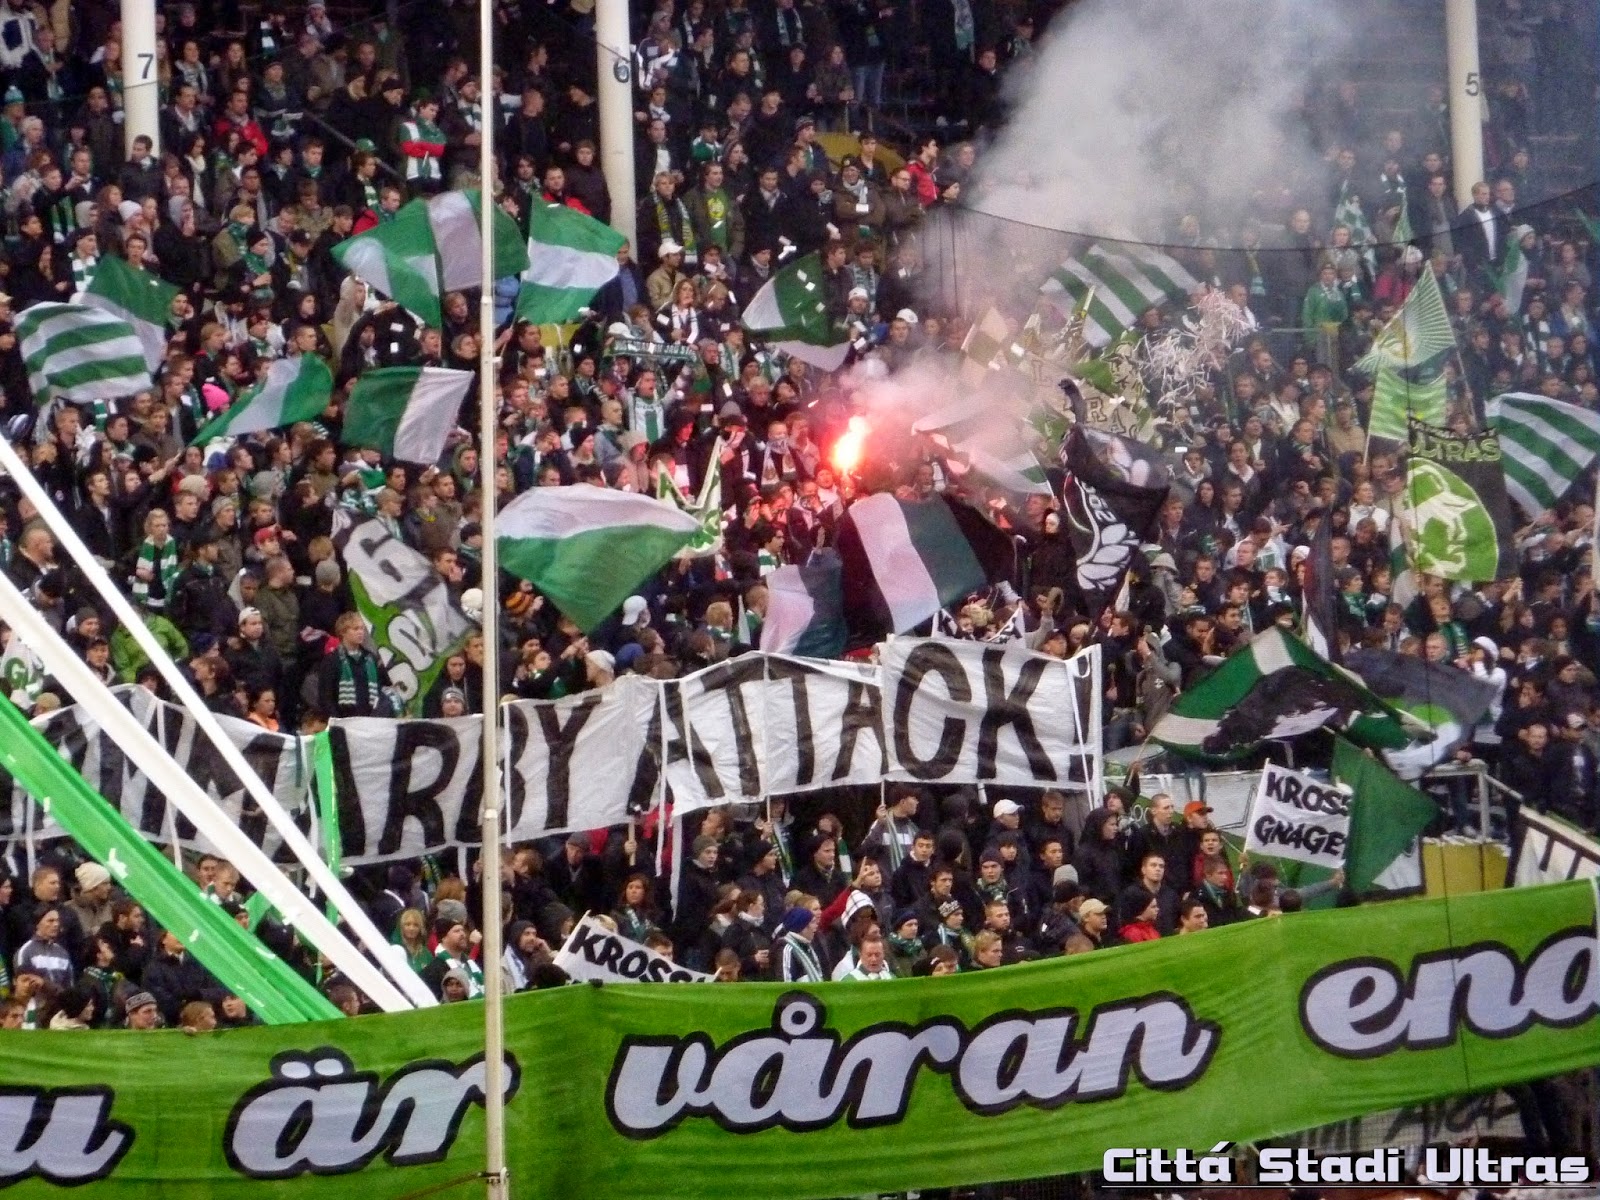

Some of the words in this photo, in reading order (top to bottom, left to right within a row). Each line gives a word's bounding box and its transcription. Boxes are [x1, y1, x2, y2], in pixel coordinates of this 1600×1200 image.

[137, 53, 154, 79] 7
[613, 58, 630, 83] 6
[1465, 71, 1479, 97] 5
[223, 1046, 522, 1180] är
[604, 990, 1222, 1139] våran
